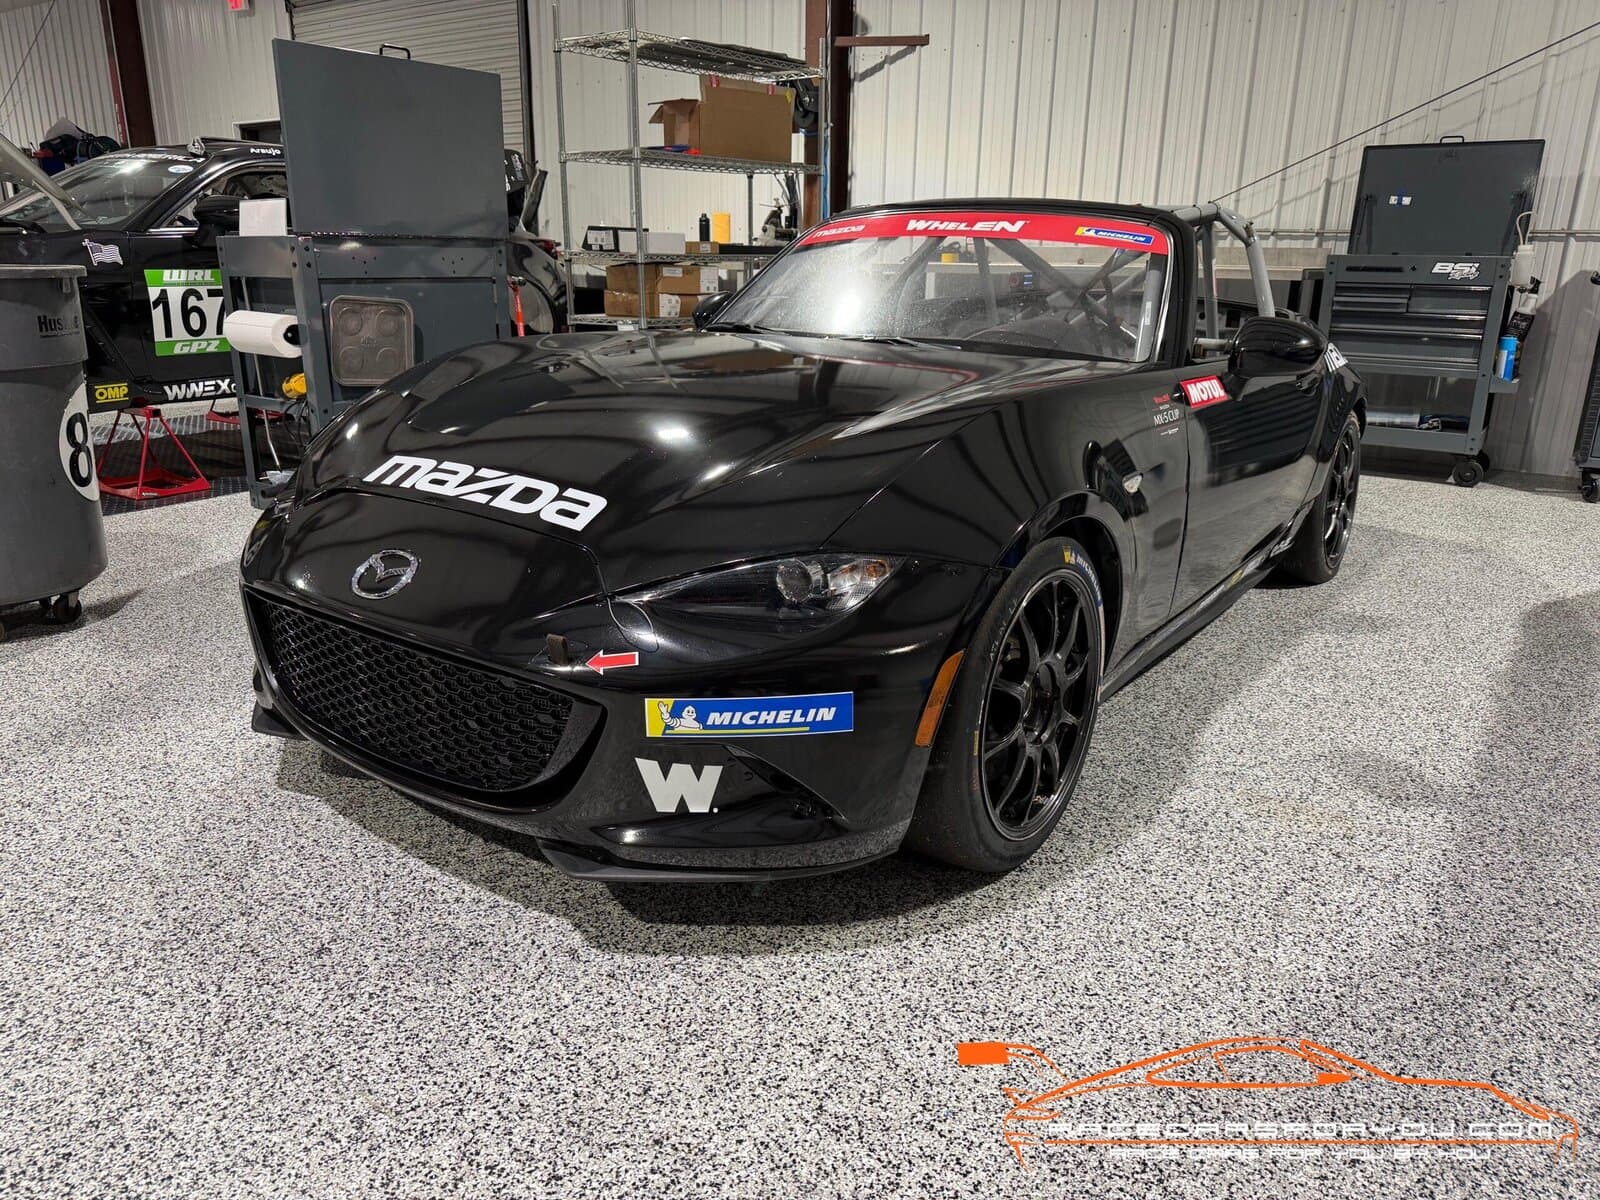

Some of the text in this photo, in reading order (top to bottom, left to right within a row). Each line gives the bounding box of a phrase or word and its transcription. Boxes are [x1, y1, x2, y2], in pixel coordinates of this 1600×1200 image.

[250, 148, 281, 156] Araujo
[906, 219, 1026, 233] WHELEN
[1099, 231, 1146, 242] MICHELIN
[163, 269, 215, 281] WRL
[152, 288, 226, 338] 167
[95, 386, 128, 400] OMP
[1187, 379, 1226, 404] MOTUL
[1168, 409, 1180, 421] CUP
[66, 412, 93, 488] 8
[706, 706, 836, 726] MICHELIN
